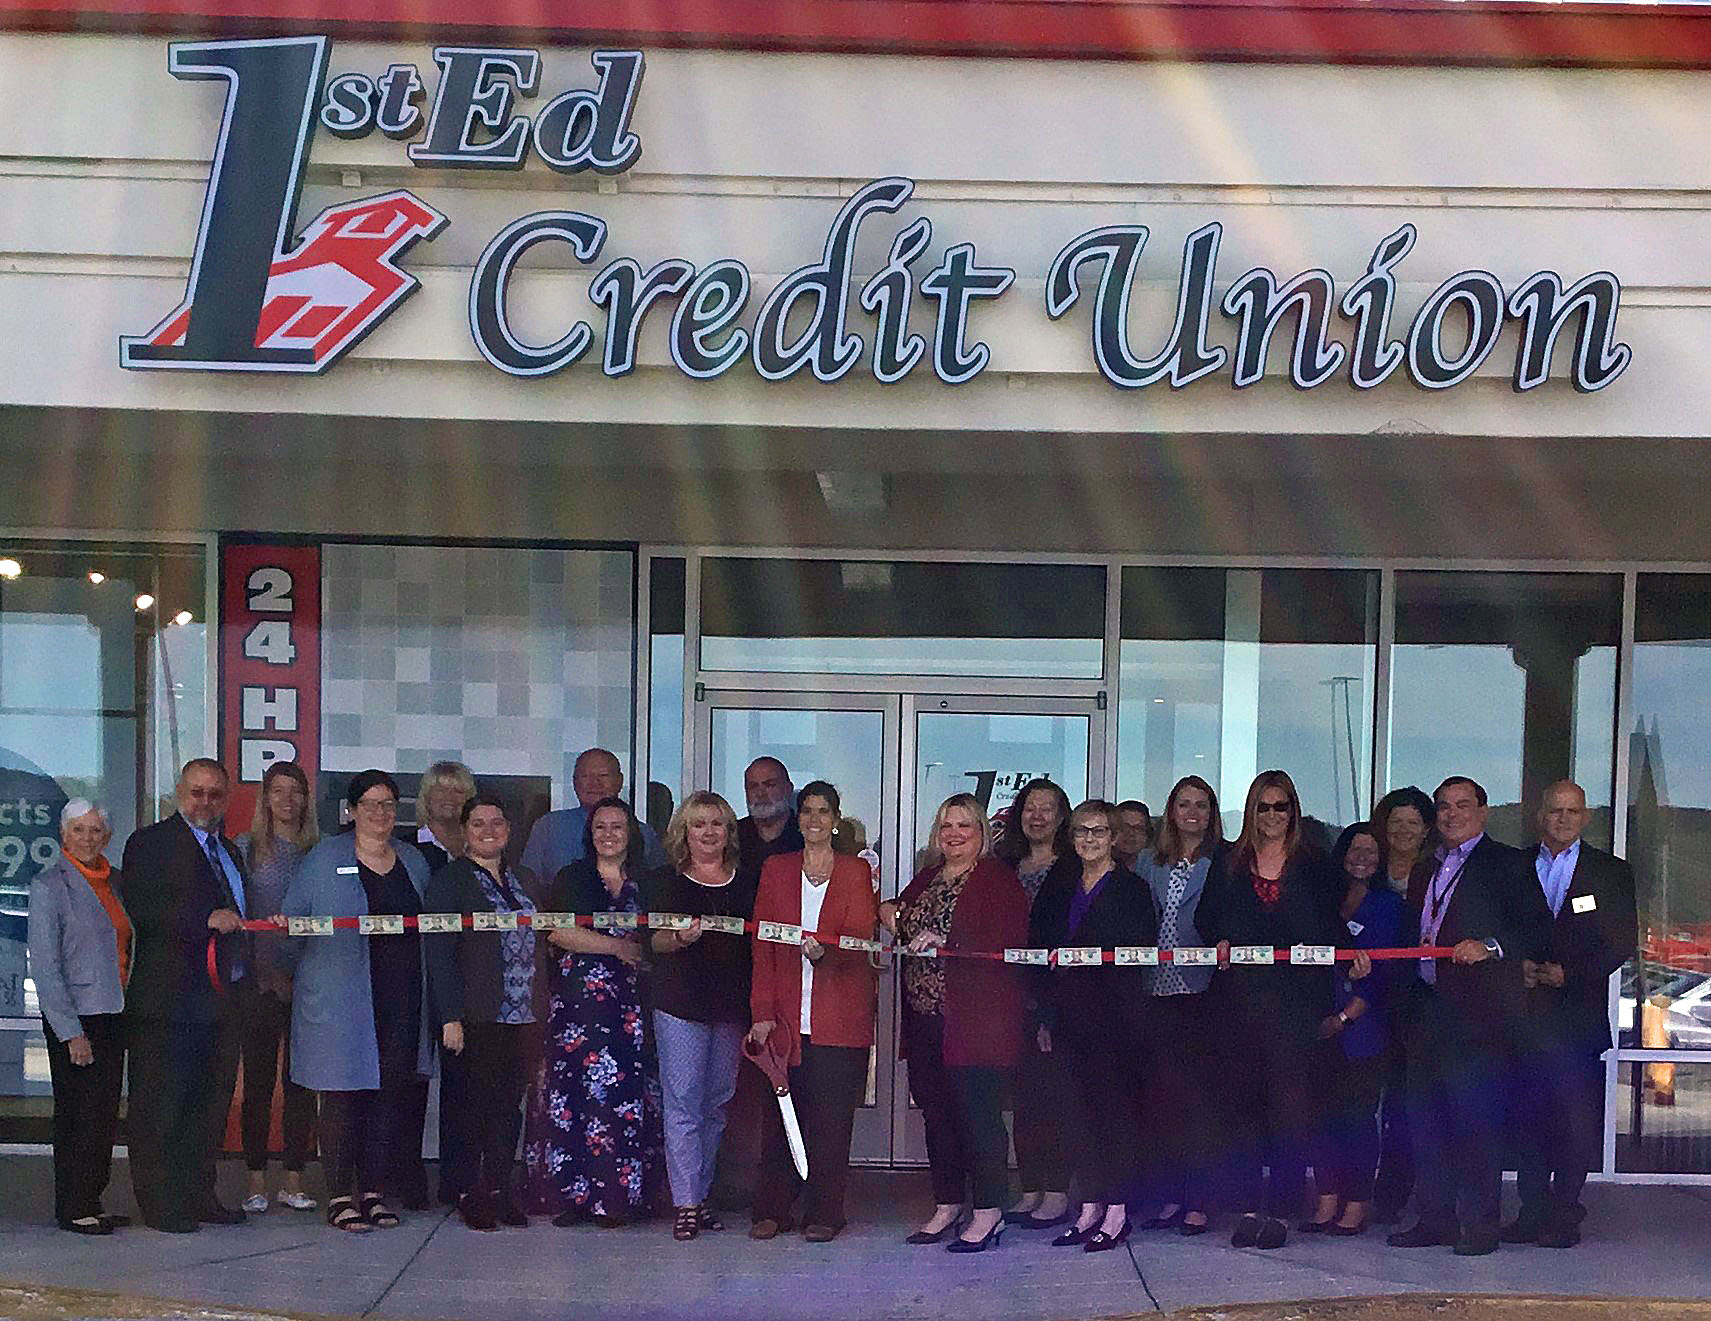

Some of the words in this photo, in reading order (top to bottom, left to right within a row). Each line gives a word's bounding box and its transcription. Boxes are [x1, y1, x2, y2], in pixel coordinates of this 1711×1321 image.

[407, 46, 643, 174] Ed
[468, 176, 1016, 386] Credit
[1045, 220, 1632, 393] Union
[244, 566, 296, 664] 24
